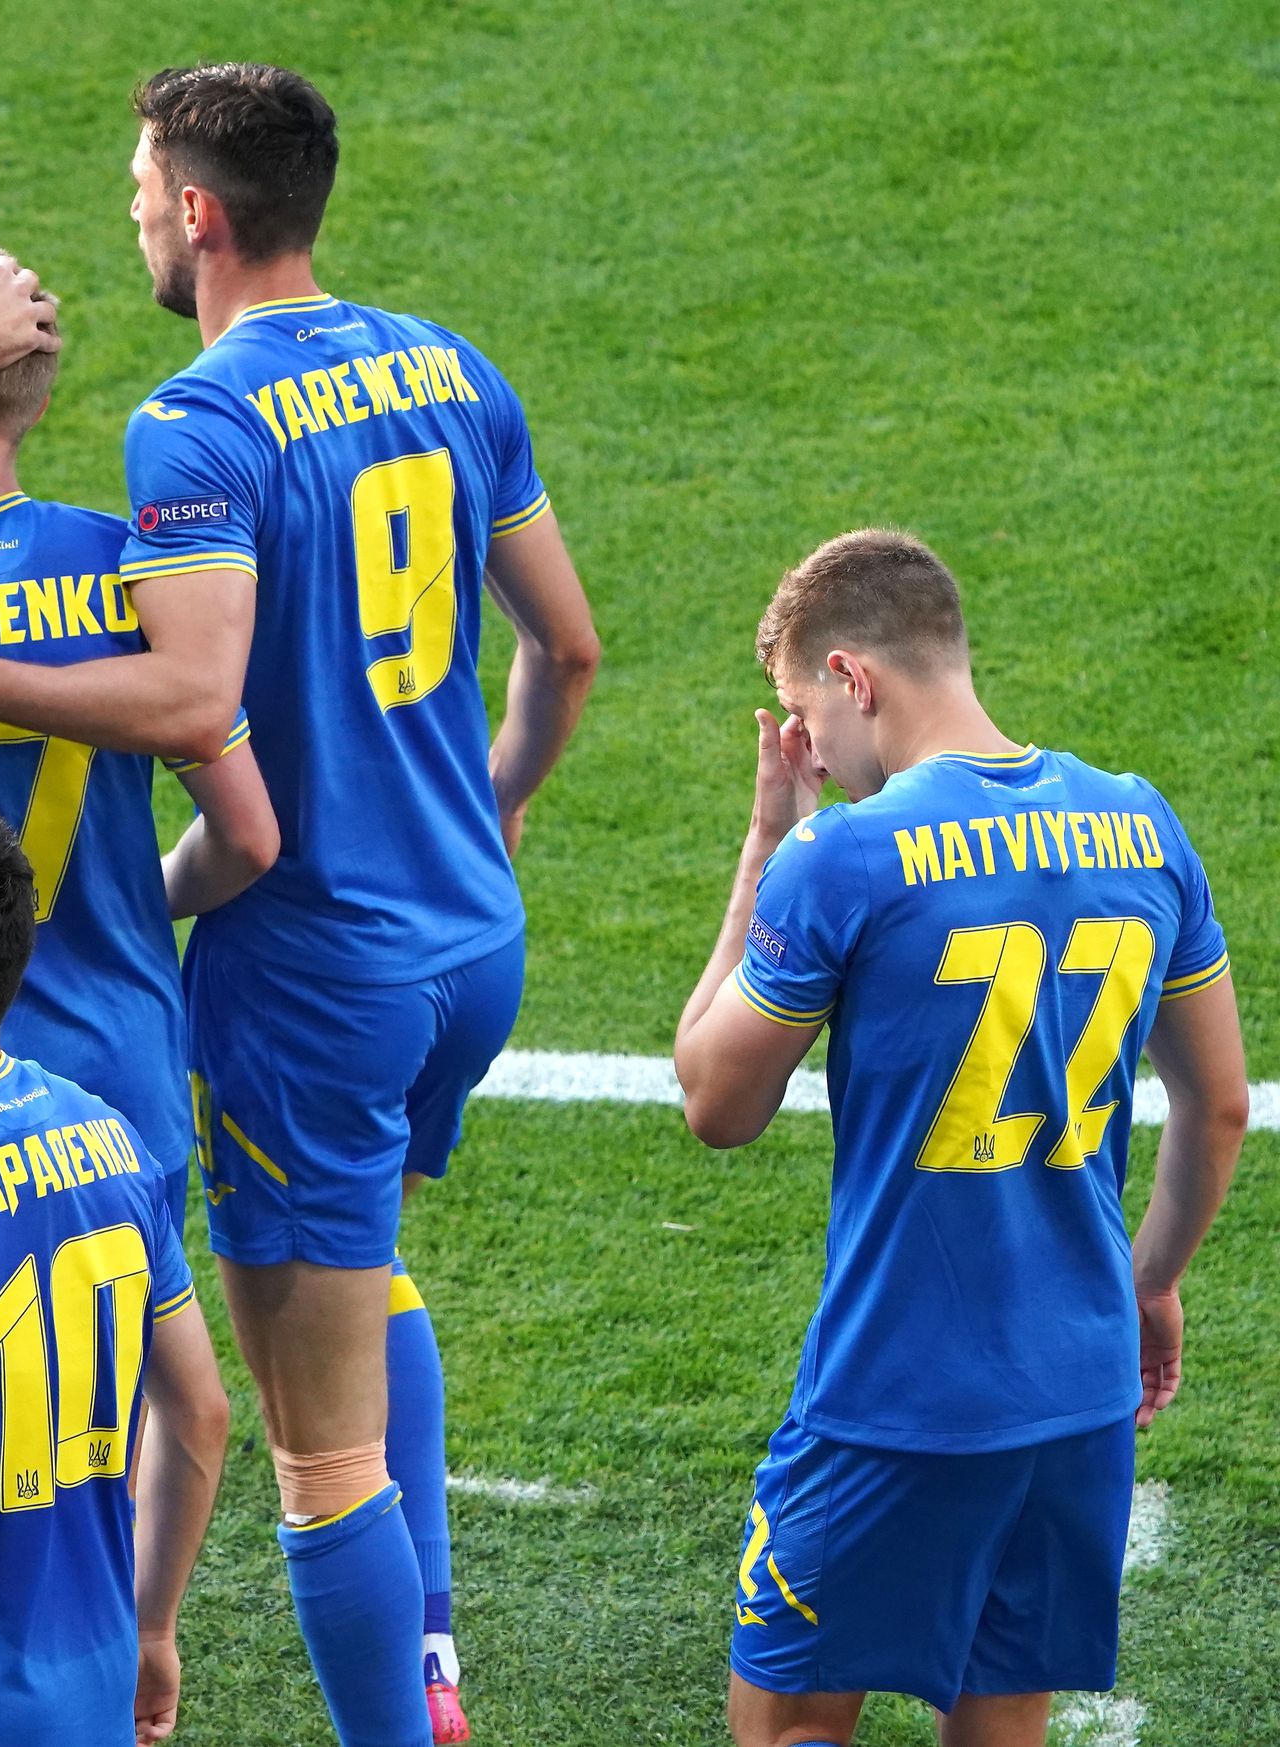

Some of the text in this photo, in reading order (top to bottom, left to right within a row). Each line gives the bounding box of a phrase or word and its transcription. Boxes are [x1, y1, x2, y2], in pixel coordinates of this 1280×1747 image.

[160, 502, 229, 522] RESPECT
[350, 447, 457, 715] 9
[893, 810, 1165, 888] MATVIYENKO
[749, 918, 785, 958] ESPECT
[914, 916, 1156, 1172] 22
[738, 1499, 770, 1601] 2
